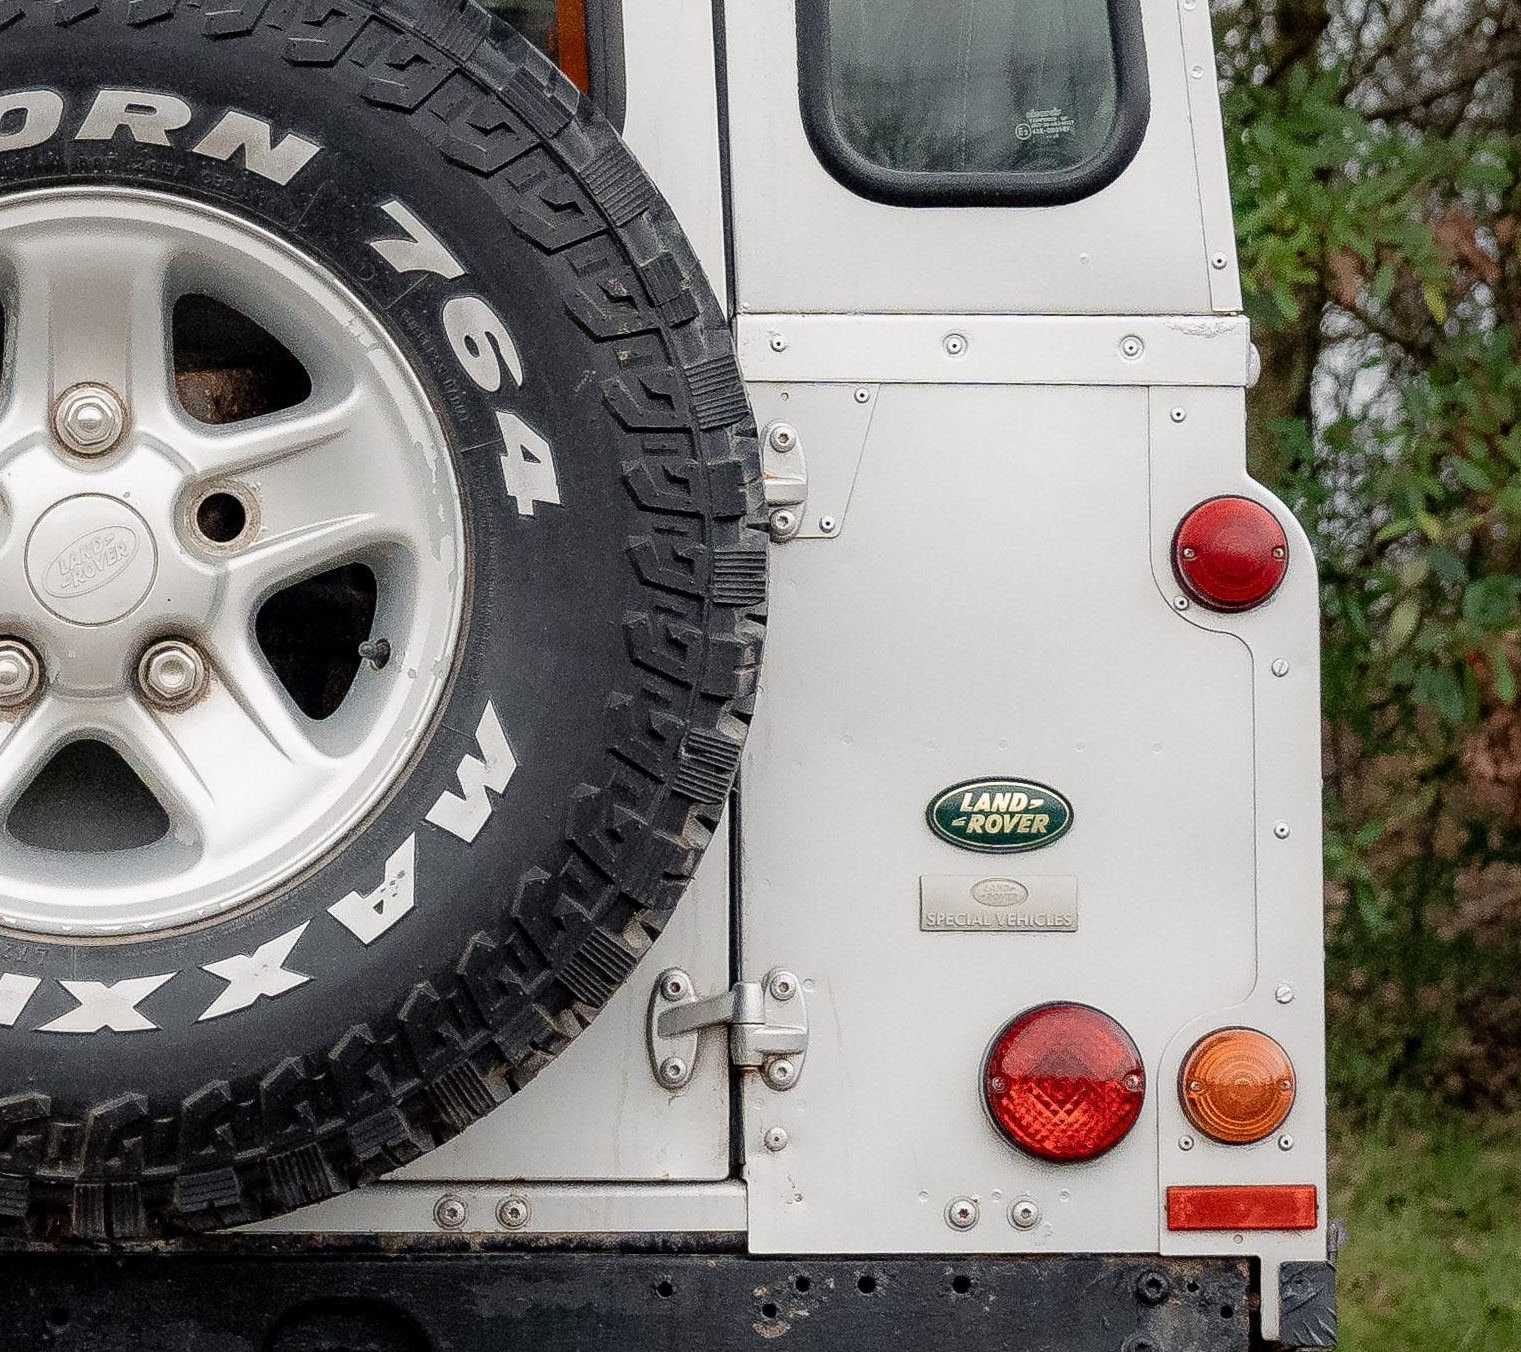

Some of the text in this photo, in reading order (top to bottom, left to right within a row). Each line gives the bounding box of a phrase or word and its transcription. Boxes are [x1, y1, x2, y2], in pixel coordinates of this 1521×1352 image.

[369, 199, 562, 518] 764
[58, 536, 105, 577] LAND
[70, 542, 131, 588] ROVER
[959, 792, 1029, 813] LAND
[966, 814, 1050, 834] ROVER
[925, 911, 1072, 927] SPECIAL VEHICLES
